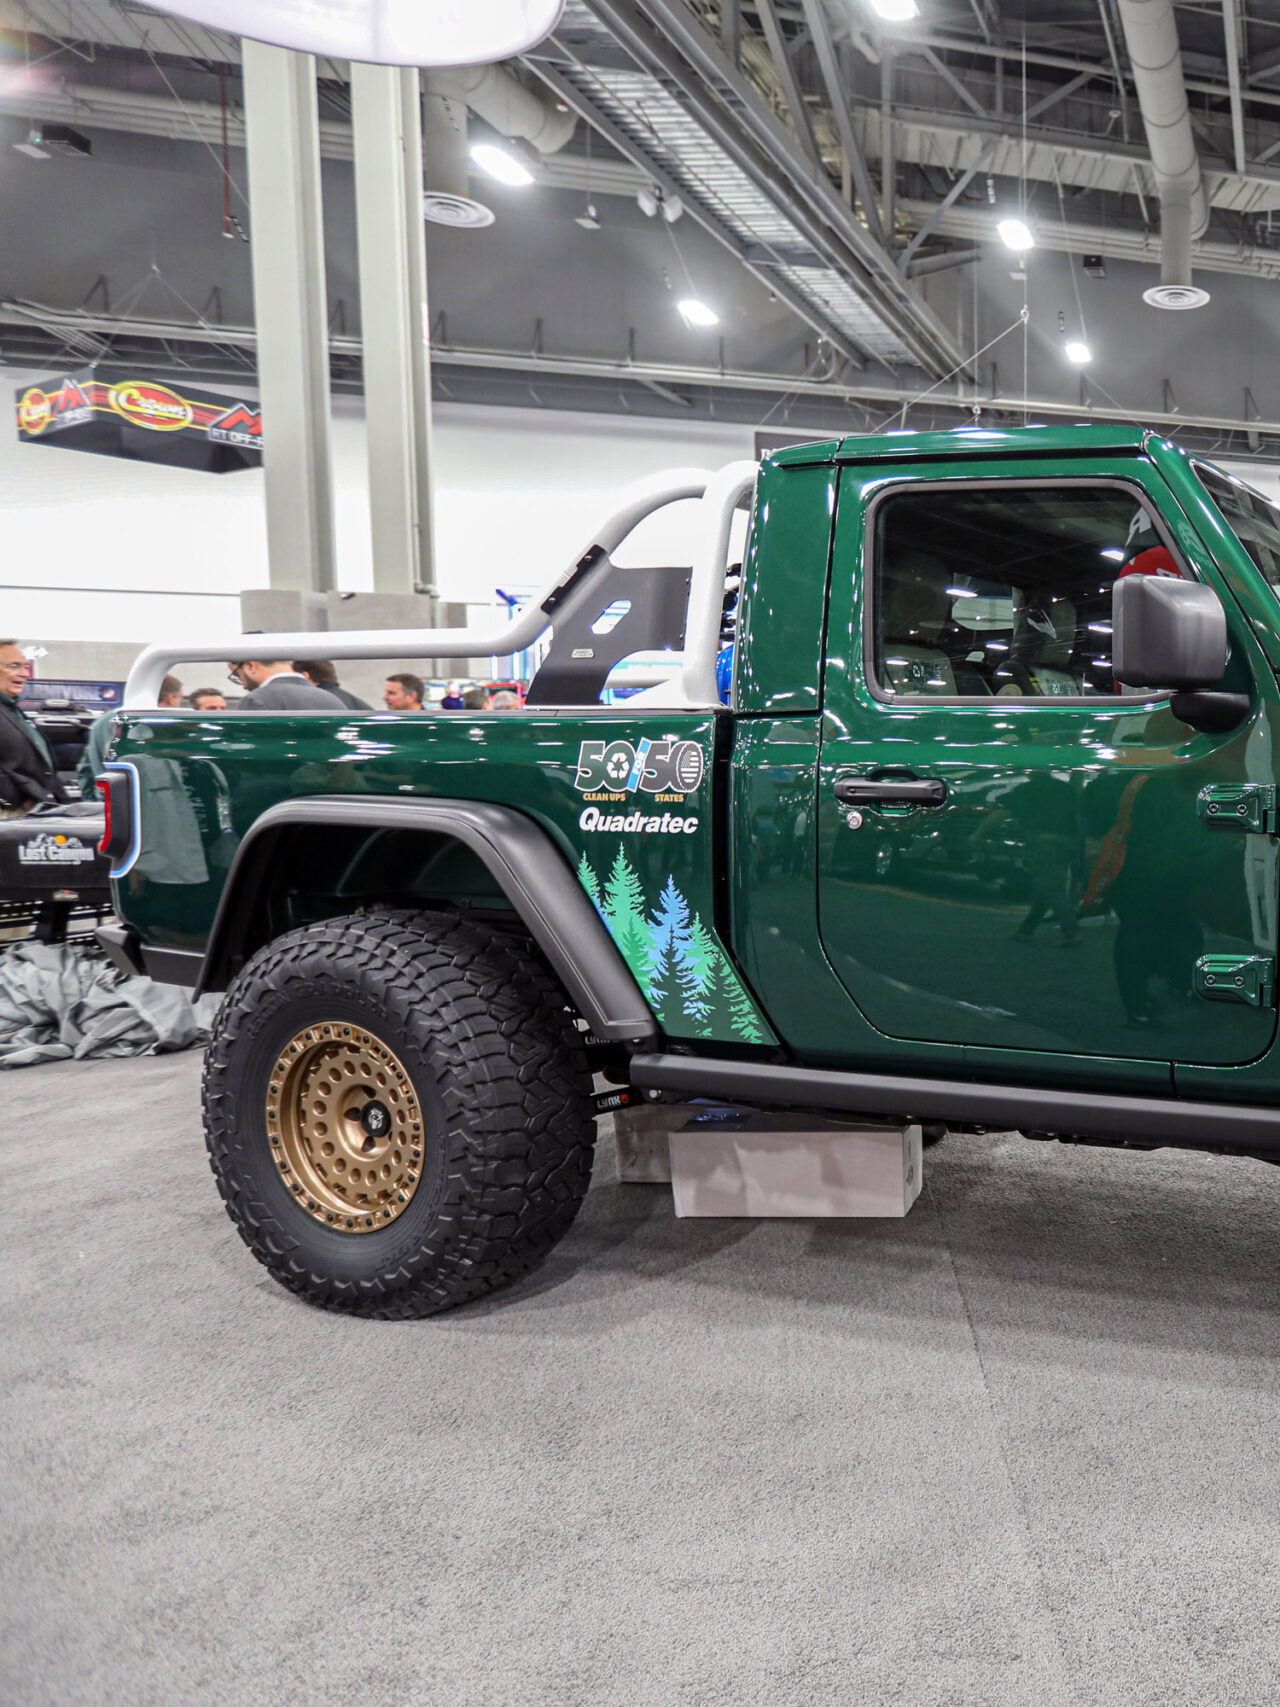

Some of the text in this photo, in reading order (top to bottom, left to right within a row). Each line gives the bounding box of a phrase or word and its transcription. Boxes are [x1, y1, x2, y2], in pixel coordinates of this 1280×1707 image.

[574, 740, 637, 793] 50
[639, 740, 704, 793] 50
[583, 793, 626, 802] CLEAN UPS
[655, 793, 685, 803] STATES
[579, 806, 699, 834] Quadratec
